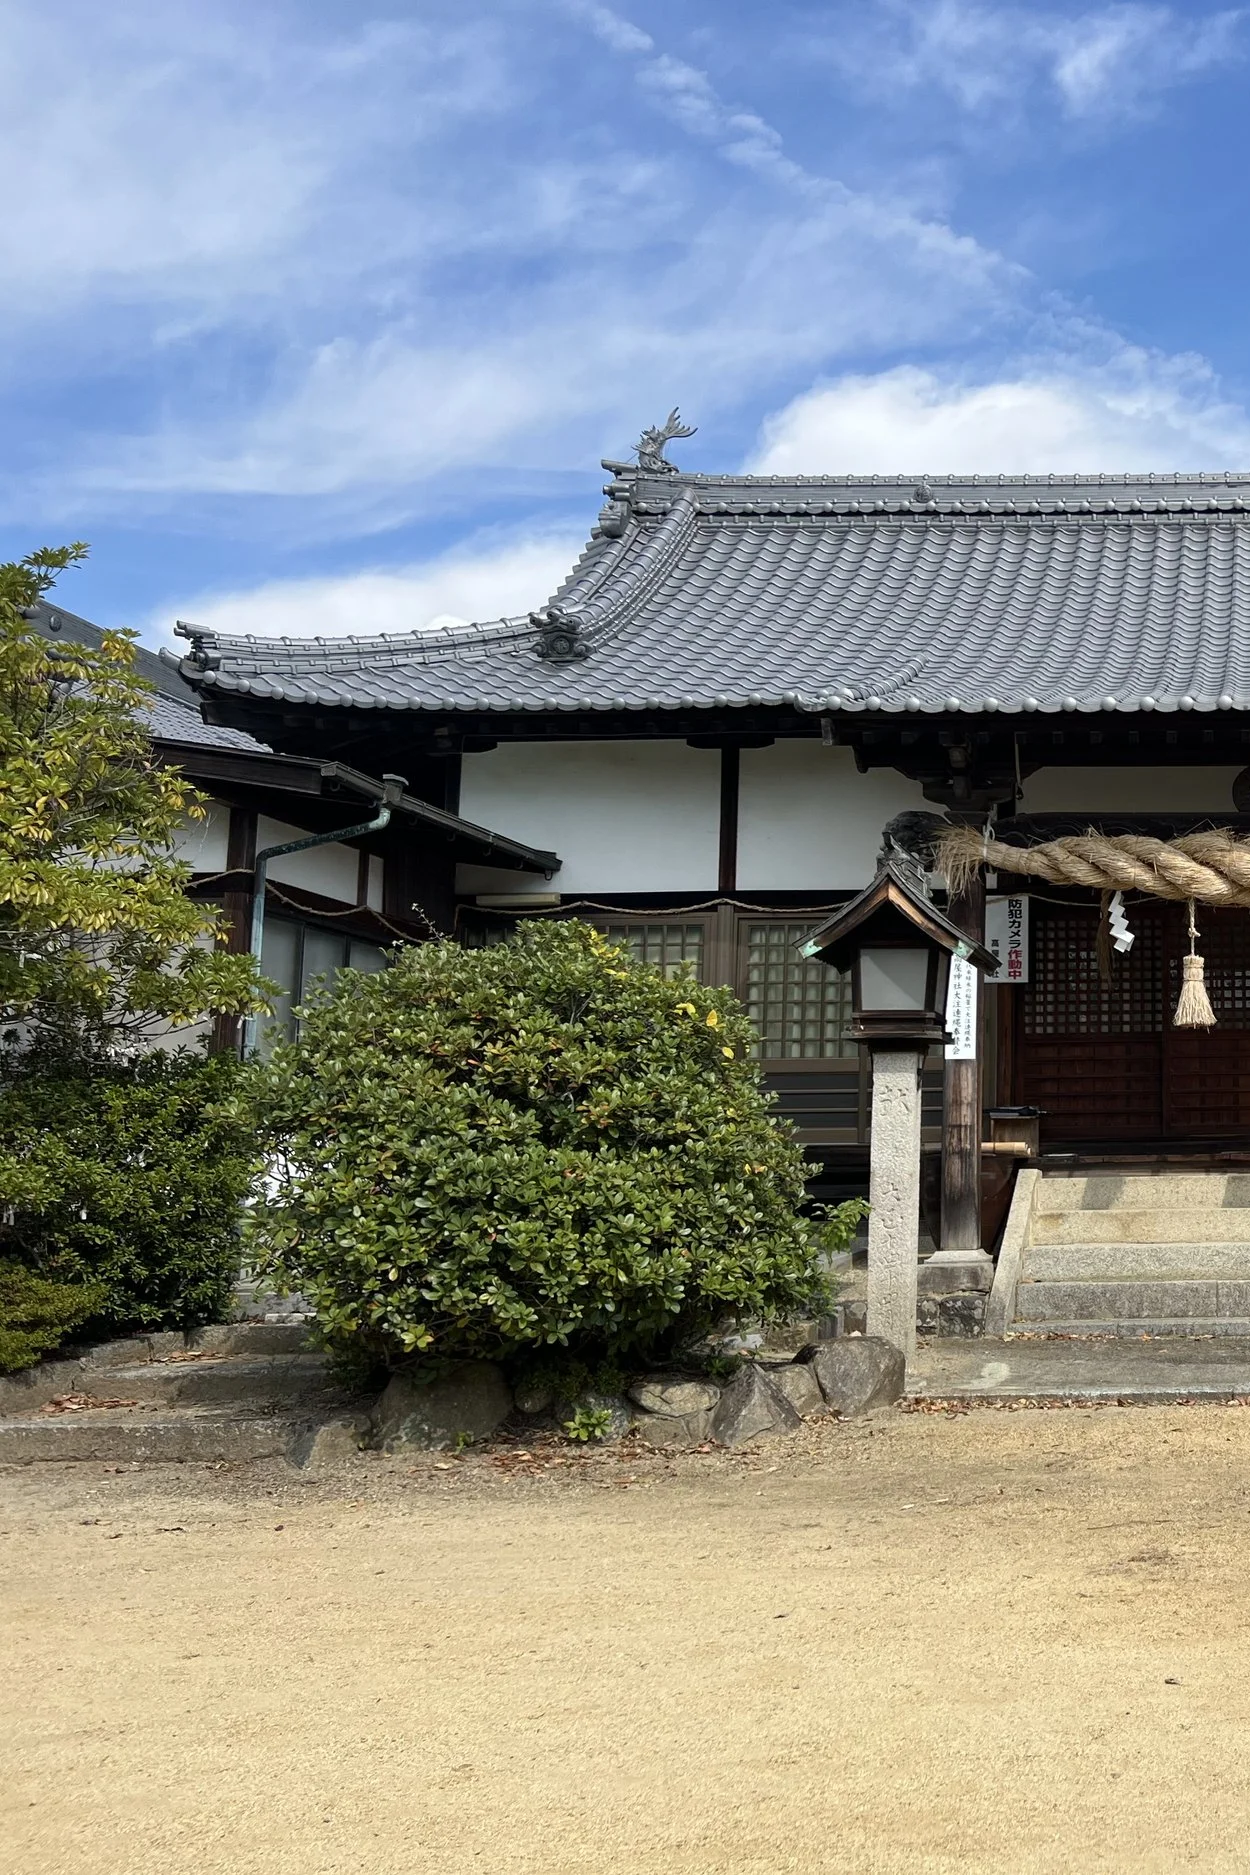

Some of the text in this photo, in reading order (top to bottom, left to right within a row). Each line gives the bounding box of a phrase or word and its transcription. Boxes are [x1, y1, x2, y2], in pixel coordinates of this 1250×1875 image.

[1008, 899, 1022, 980] 防犯カメラ作動中
